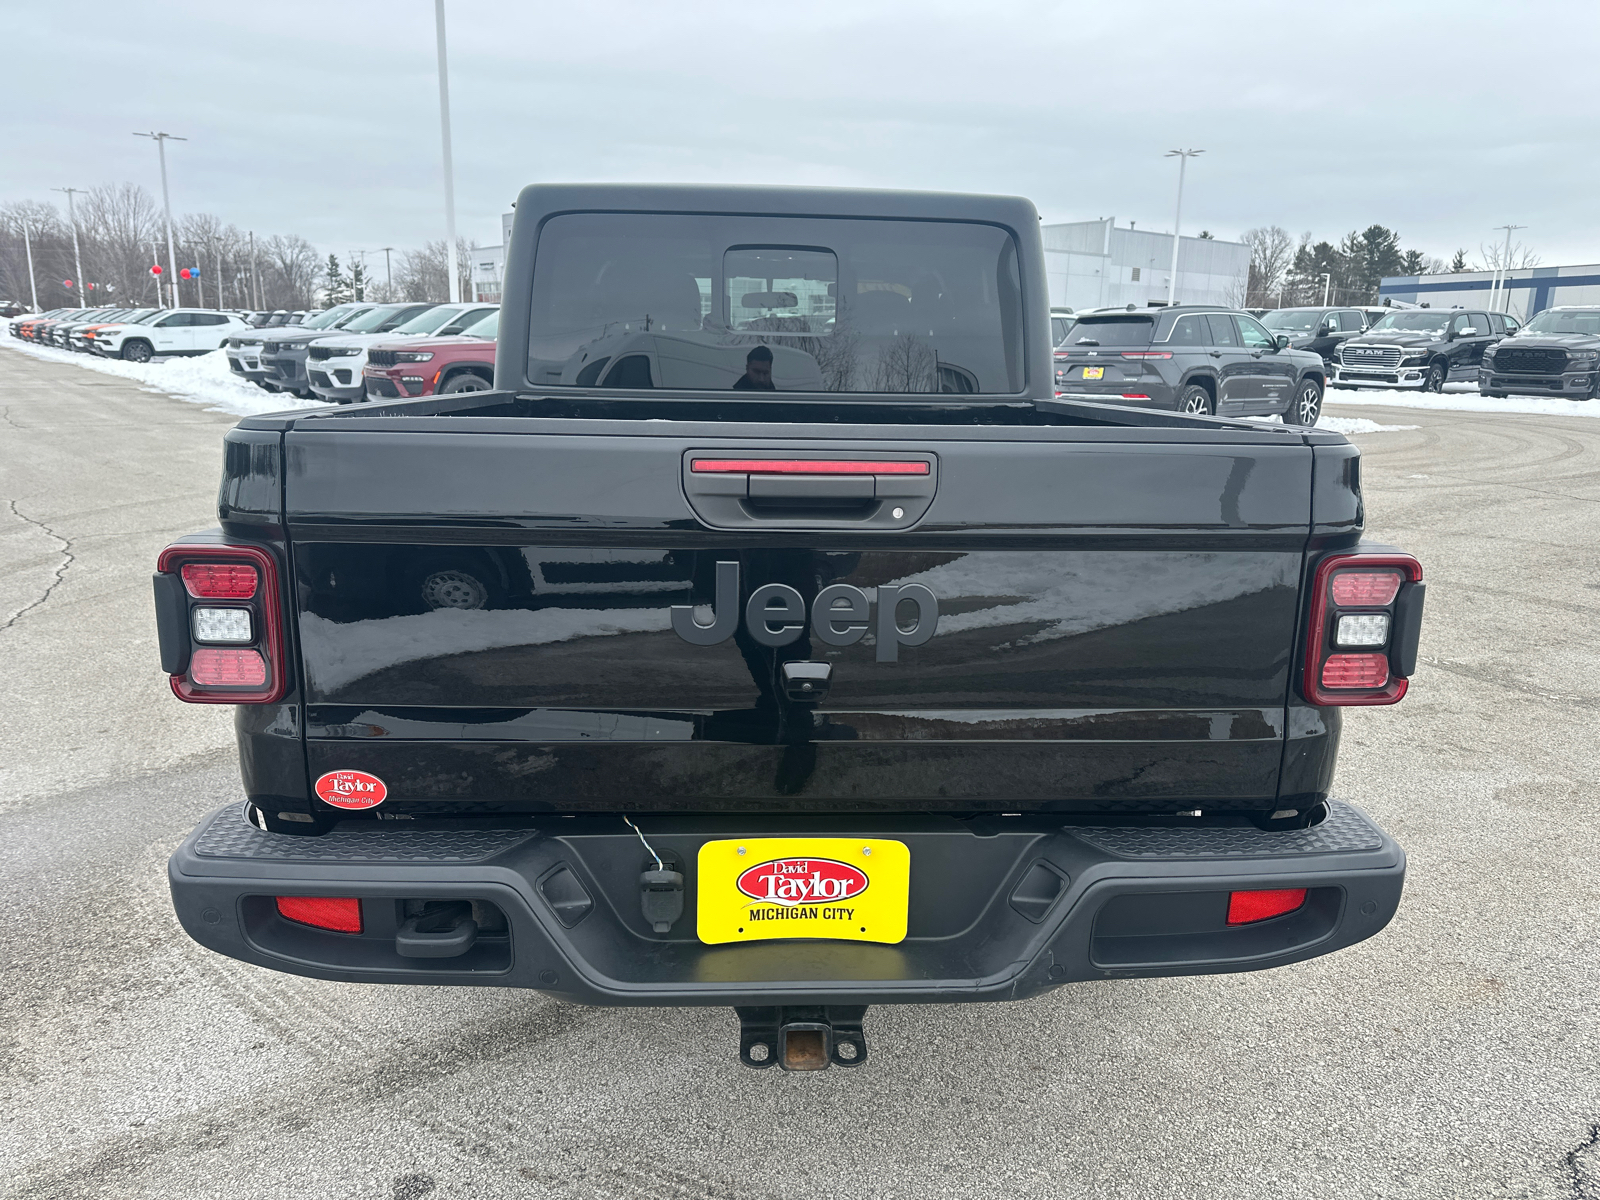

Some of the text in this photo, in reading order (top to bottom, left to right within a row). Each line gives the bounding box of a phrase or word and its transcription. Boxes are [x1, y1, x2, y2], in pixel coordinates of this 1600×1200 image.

[670, 561, 939, 663] Jeep
[329, 779, 377, 793] Taylor
[328, 795, 375, 805] Michigan City
[773, 862, 808, 874] David
[758, 871, 854, 902] Taylor
[749, 908, 855, 921] MICHIGAN CITY
